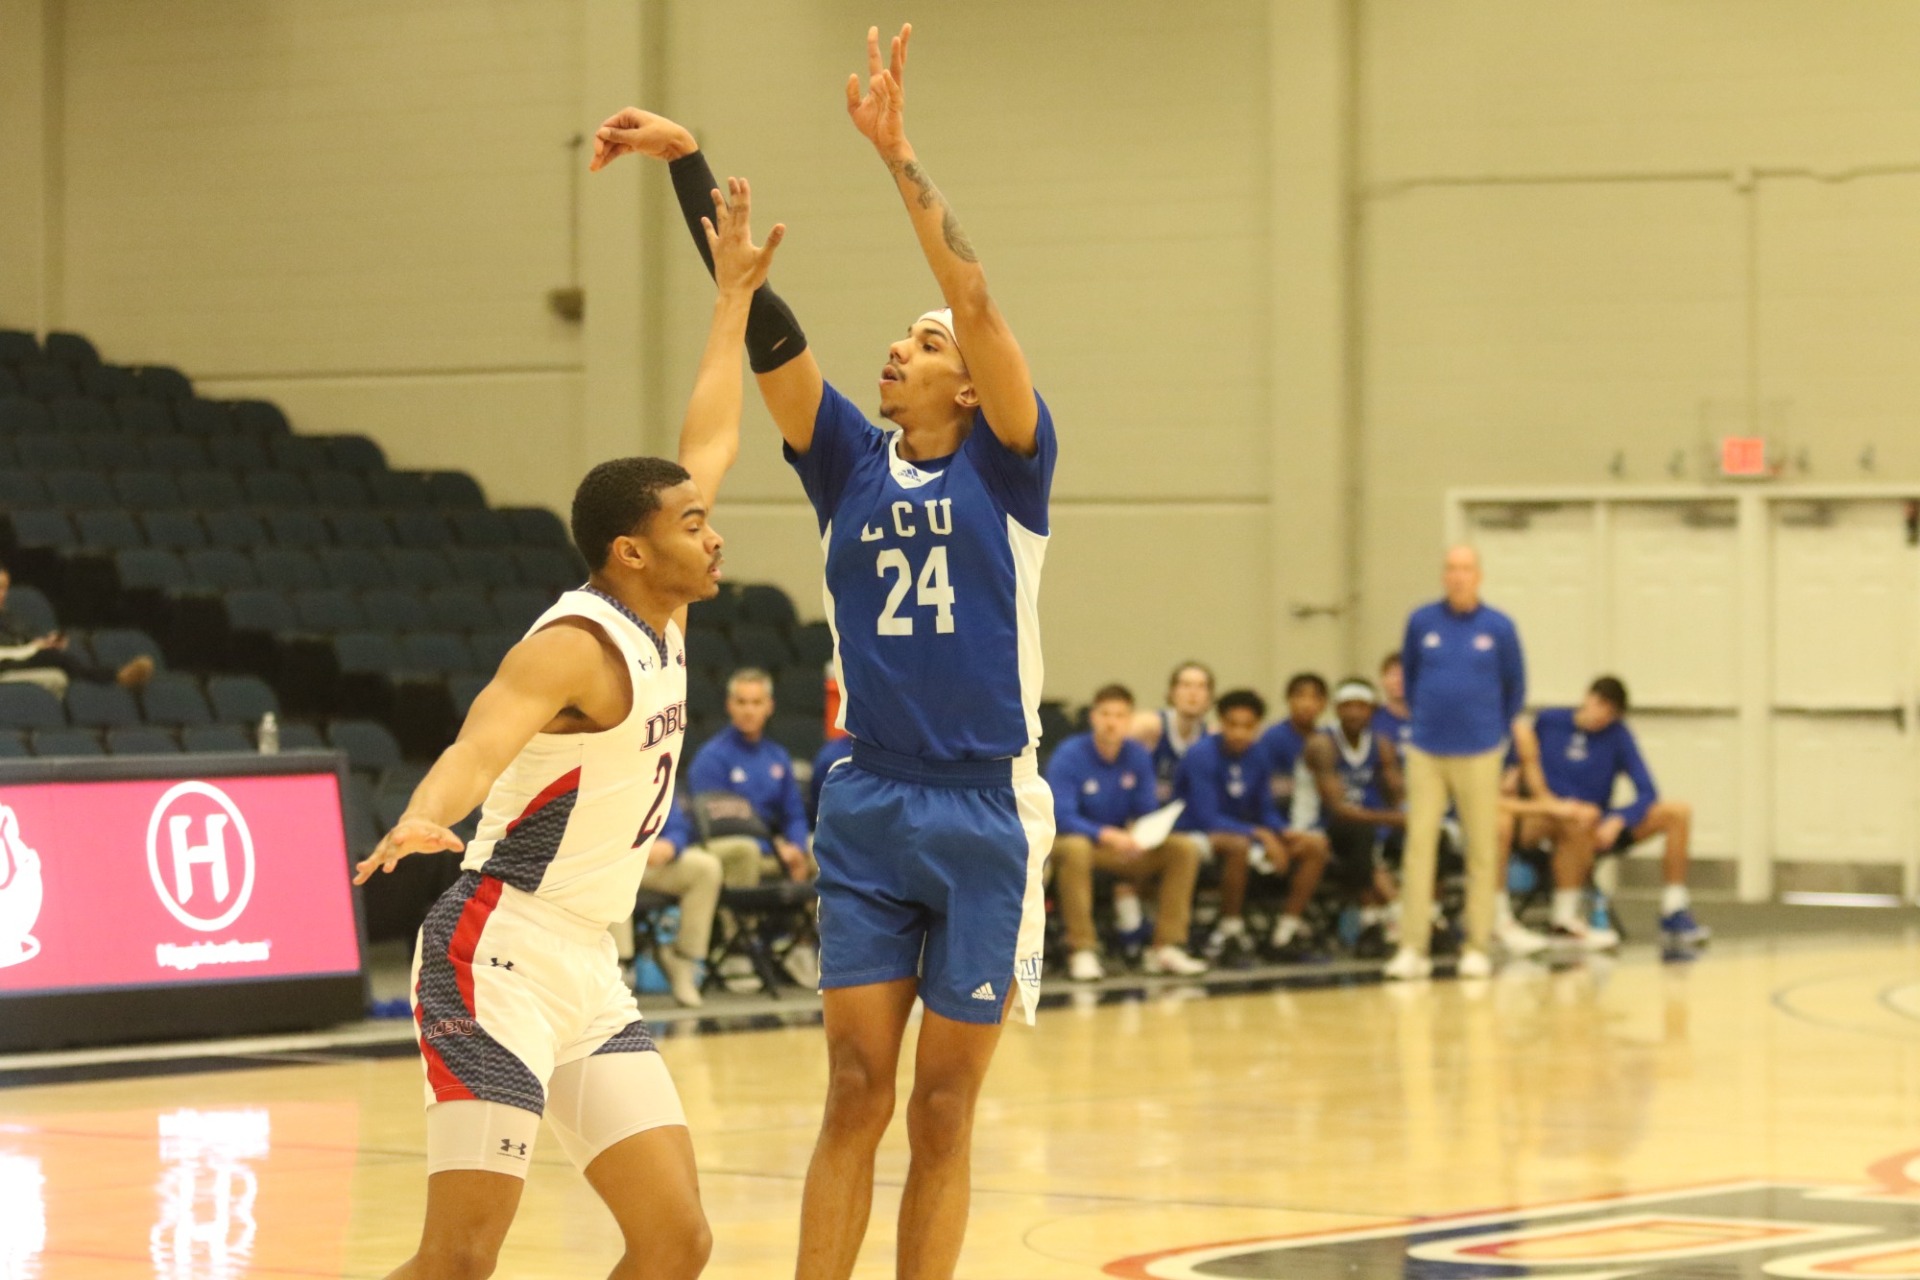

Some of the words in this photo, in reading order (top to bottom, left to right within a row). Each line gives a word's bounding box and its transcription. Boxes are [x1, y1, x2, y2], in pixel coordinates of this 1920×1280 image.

[876, 546, 956, 636] 24
[630, 752, 673, 849] 2
[169, 814, 230, 905] H
[427, 1018, 474, 1039] DBU
